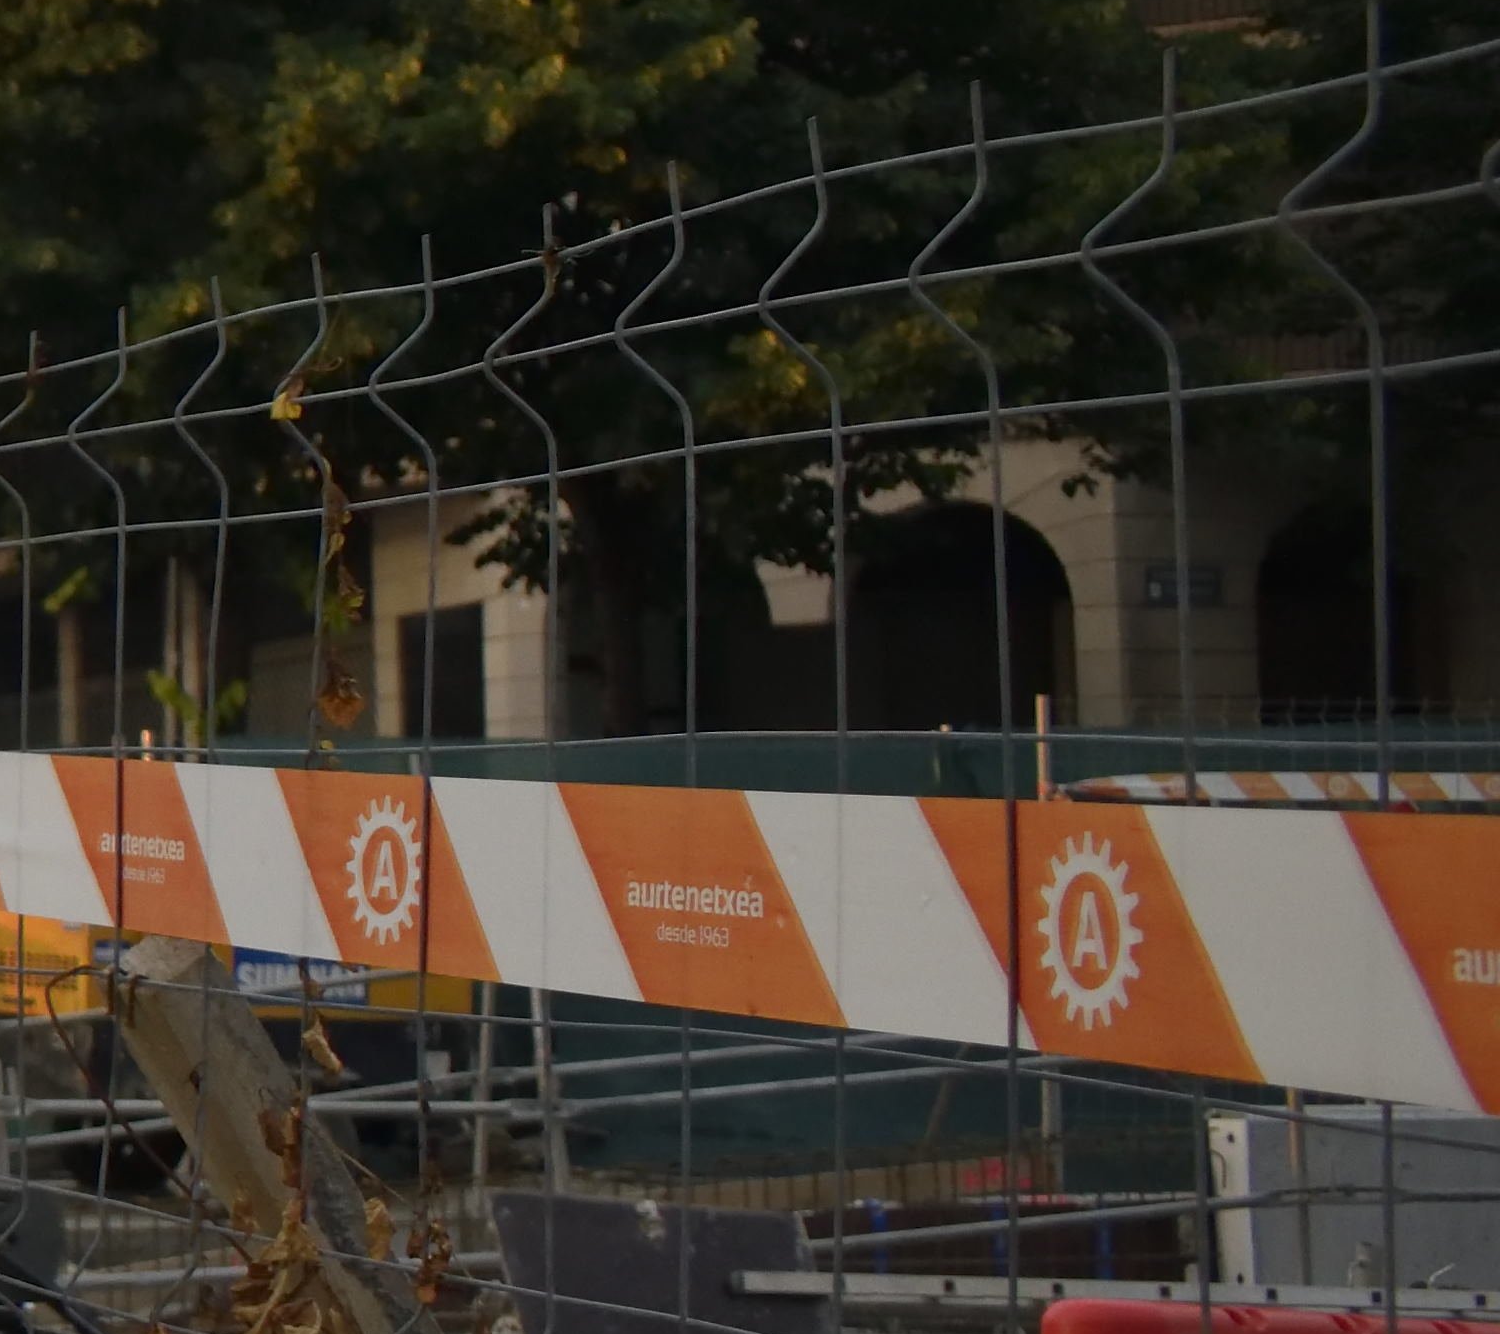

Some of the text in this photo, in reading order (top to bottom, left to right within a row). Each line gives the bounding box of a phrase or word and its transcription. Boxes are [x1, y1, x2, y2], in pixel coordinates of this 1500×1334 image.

[371, 840, 399, 901] A
[628, 879, 764, 918] aurtenetxea
[657, 921, 730, 948] desde 1963
[1071, 890, 1108, 970] A
